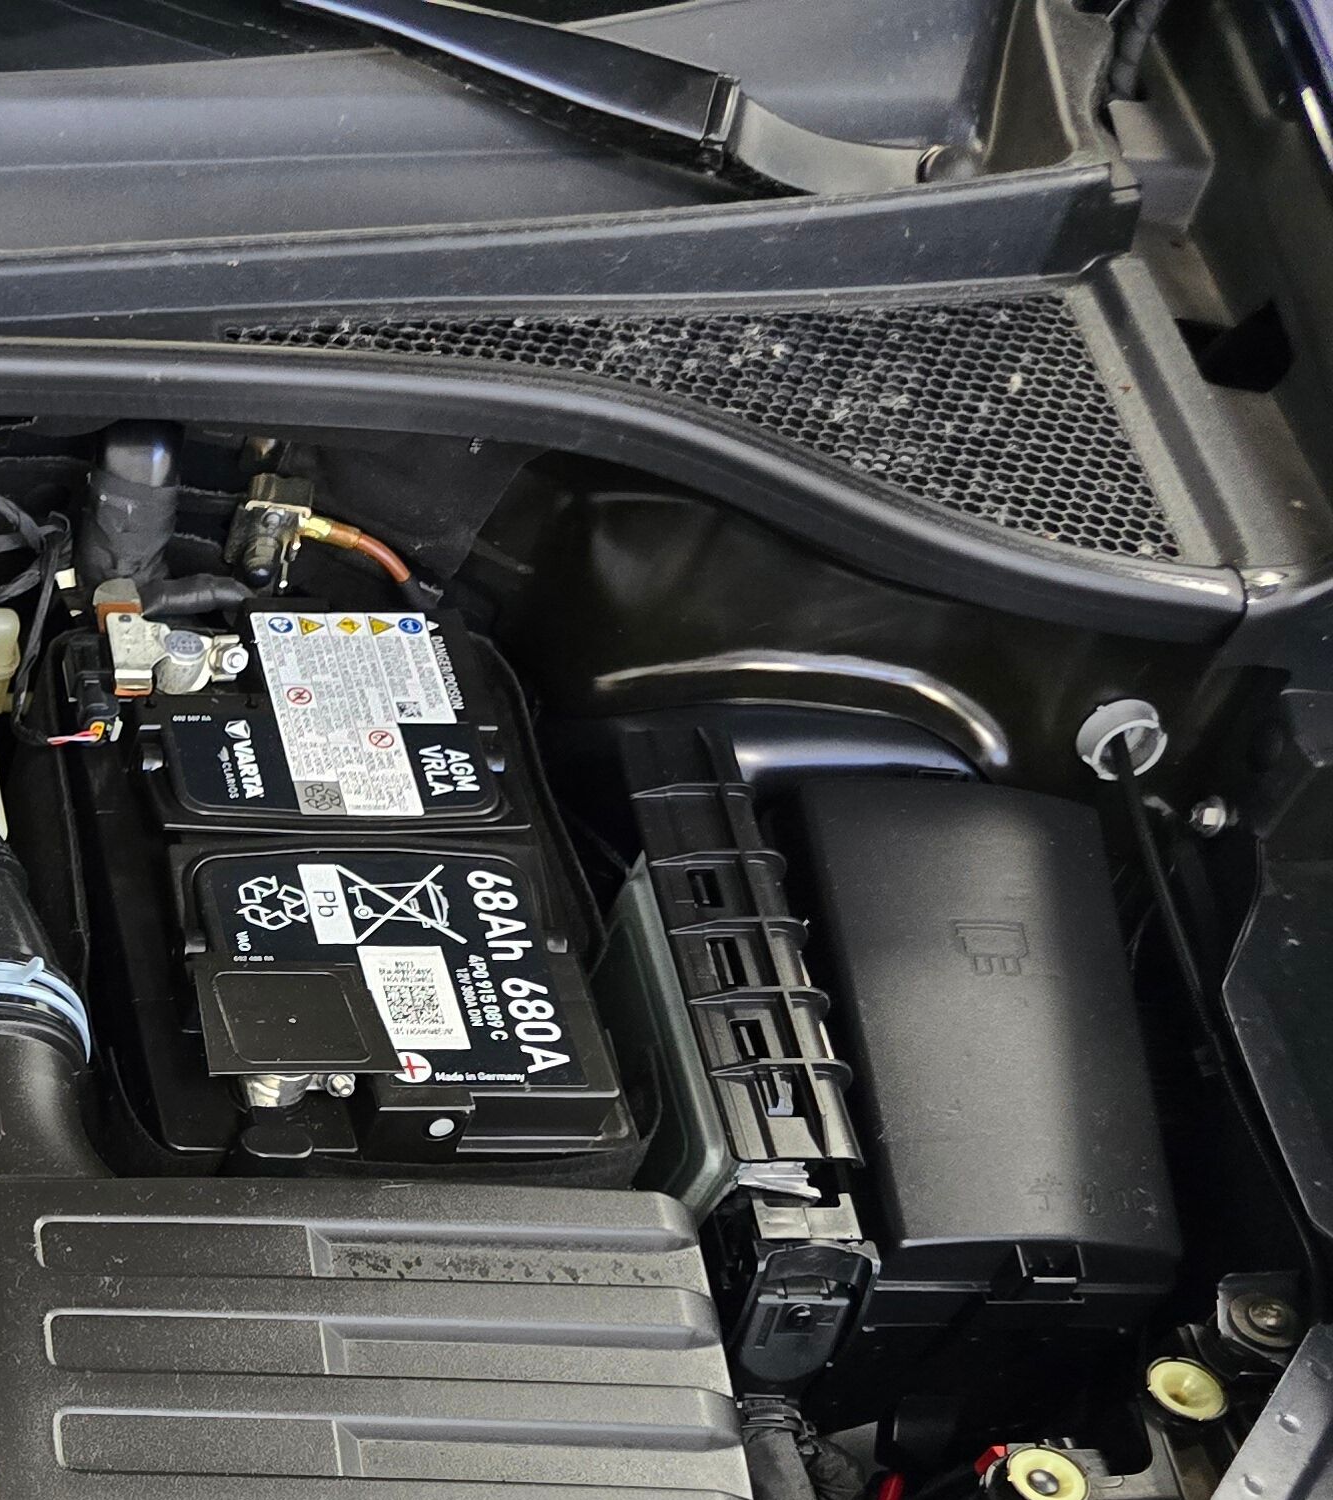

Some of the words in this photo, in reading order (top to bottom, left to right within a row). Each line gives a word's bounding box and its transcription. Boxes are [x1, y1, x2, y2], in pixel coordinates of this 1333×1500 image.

[430, 636, 465, 710] DANGER/POISON
[222, 762, 240, 799] CLARIOS
[233, 739, 264, 799] VARTA
[418, 744, 454, 796] VRLA
[444, 748, 481, 792] AGM
[313, 890, 339, 917] Pb
[467, 870, 533, 961] 68Ah
[501, 977, 571, 1074] 680A
[468, 1008, 484, 1027] DIN
[476, 980, 498, 1003] 915
[490, 1029, 508, 1041] C
[434, 1072, 464, 1082] Made
[465, 1072, 476, 1082] in
[477, 1072, 525, 1083] Germany
